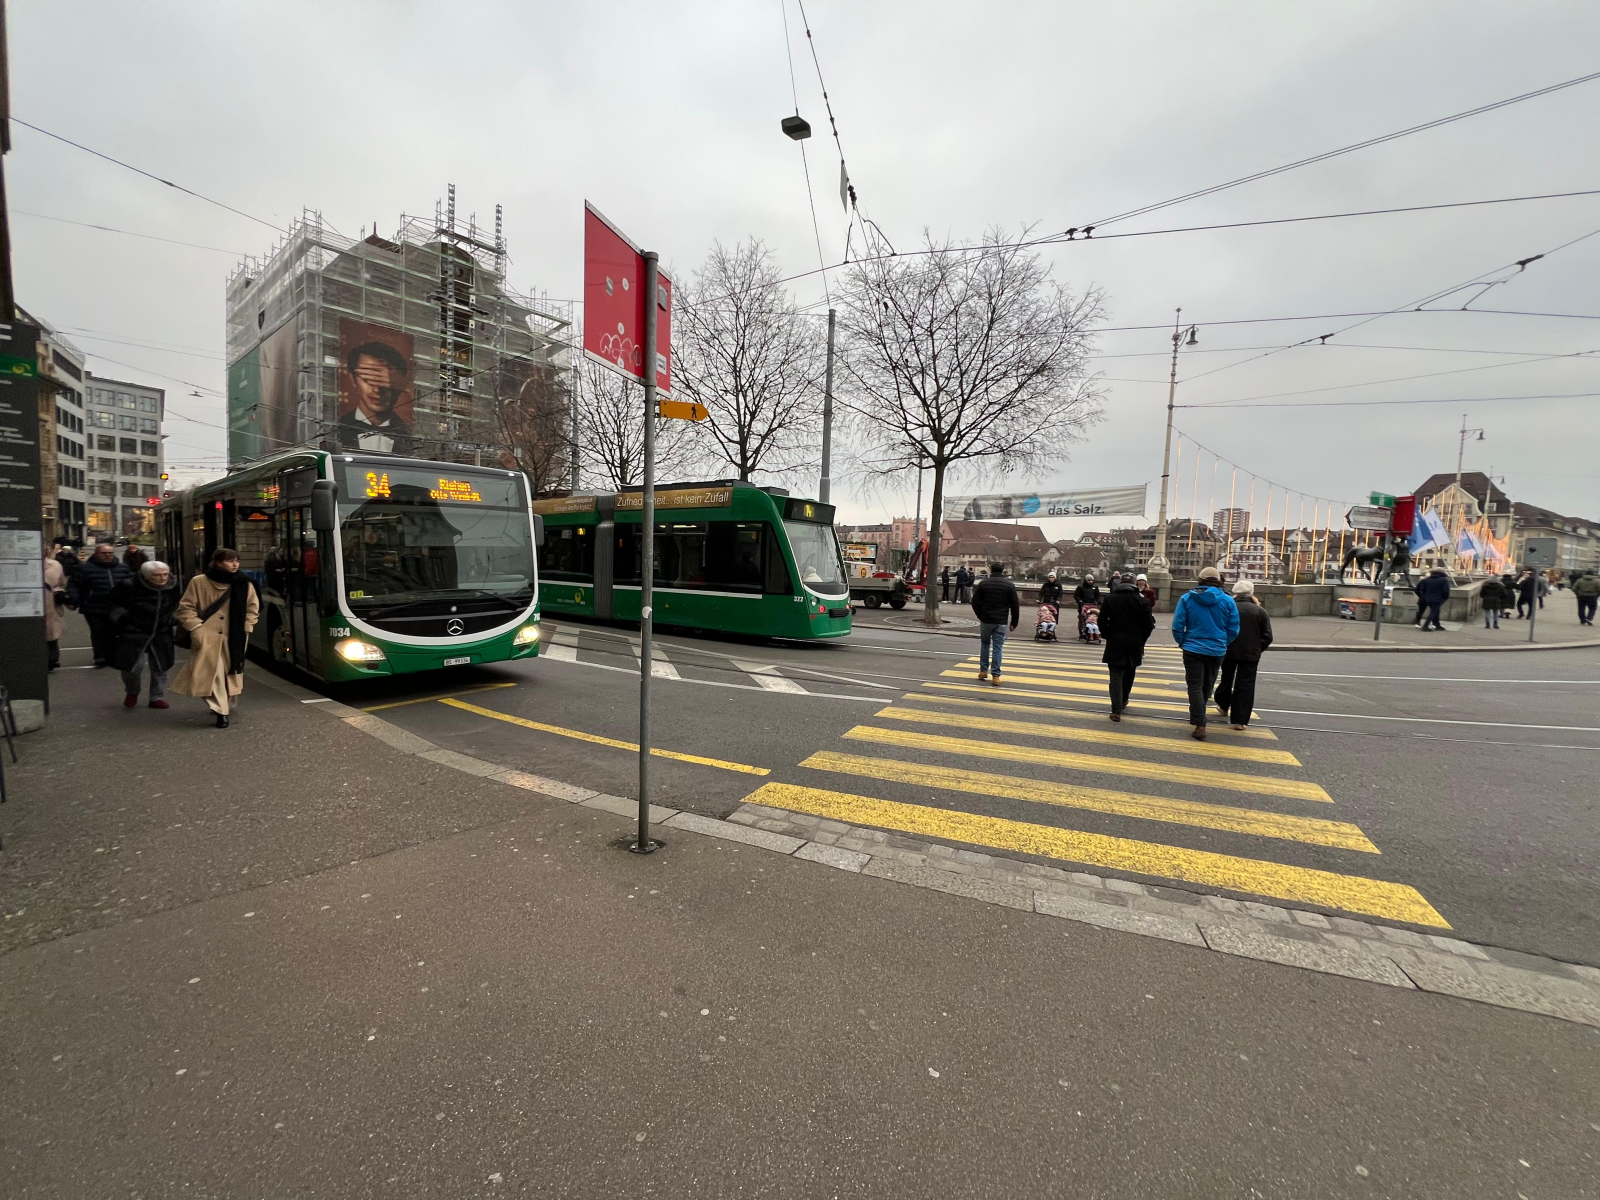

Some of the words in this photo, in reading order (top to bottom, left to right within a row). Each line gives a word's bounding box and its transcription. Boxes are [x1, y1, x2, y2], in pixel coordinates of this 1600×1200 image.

[366, 472, 391, 498] 34
[674, 494, 683, 505] ist
[685, 493, 702, 504] kein
[704, 491, 729, 503] Zufall
[1048, 505, 1070, 515] das
[1073, 503, 1105, 514] Salz.
[329, 627, 351, 637] 7034
